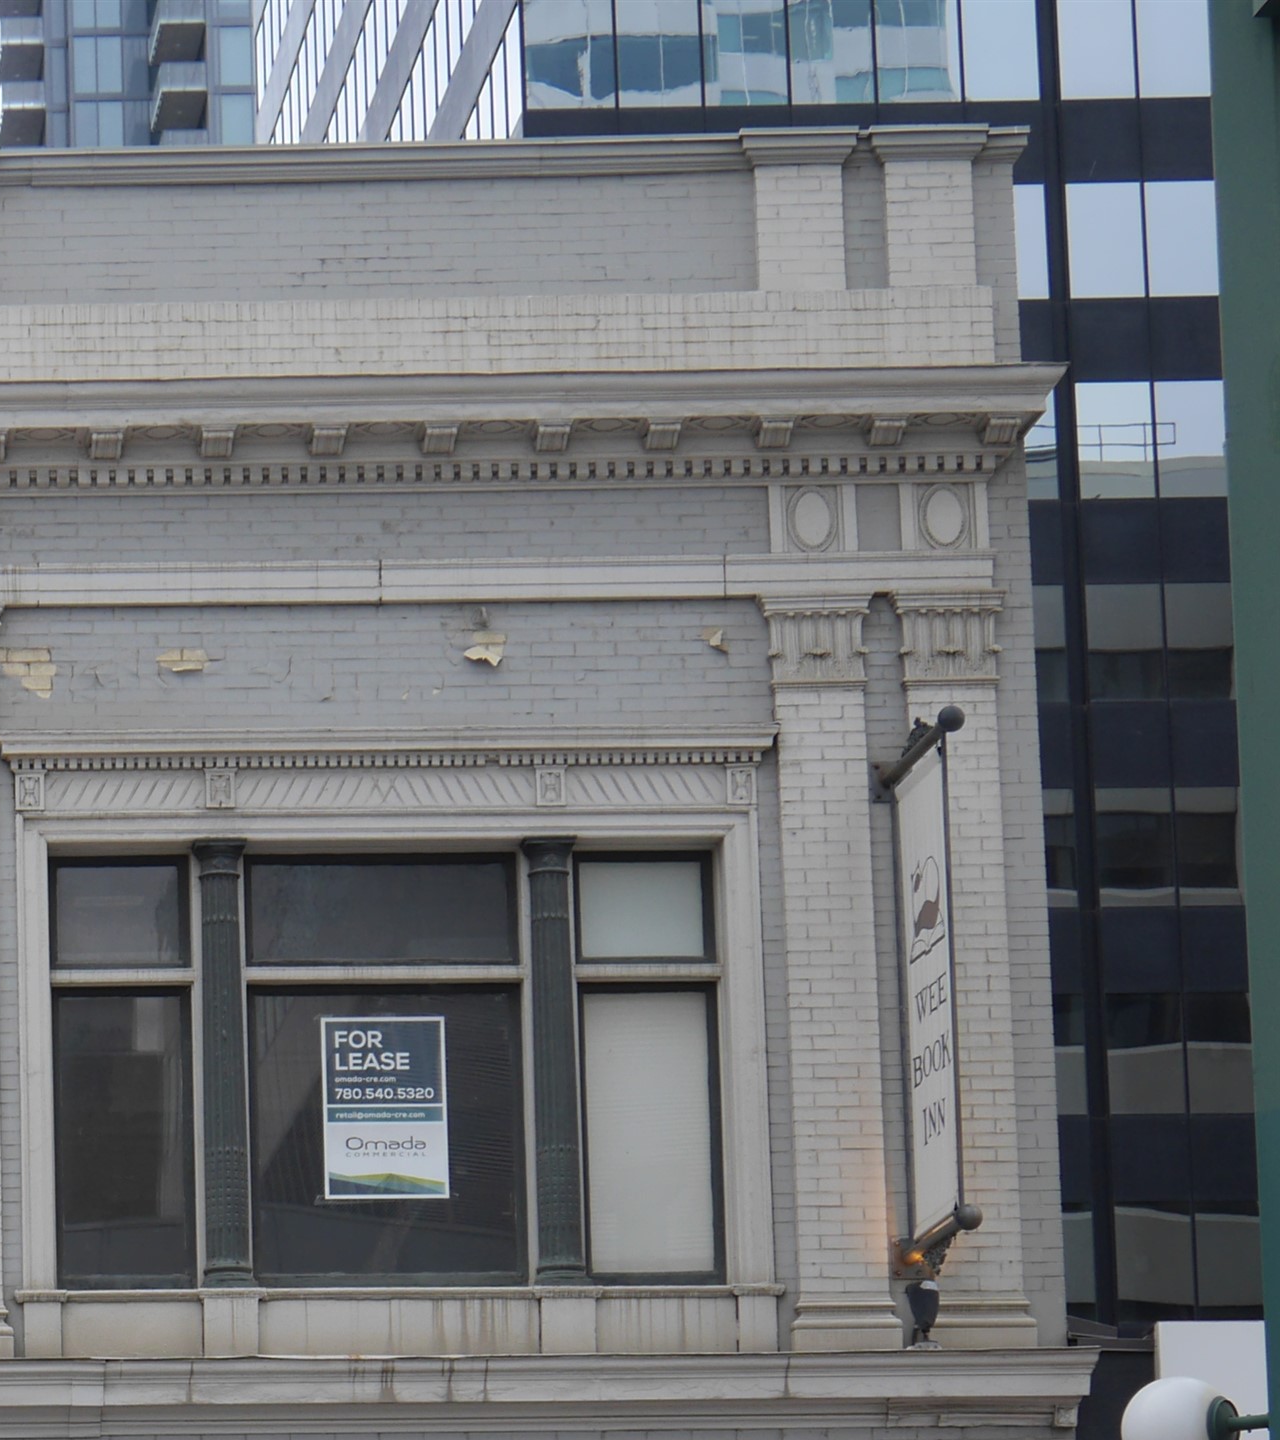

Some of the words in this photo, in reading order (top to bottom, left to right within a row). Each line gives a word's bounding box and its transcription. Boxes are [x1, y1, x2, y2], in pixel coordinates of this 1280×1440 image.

[914, 971, 949, 1023] WEE
[334, 1030, 383, 1049] FOR
[334, 1052, 410, 1071] LEASE
[912, 1033, 953, 1090] BOOK
[335, 1087, 435, 1100] 780.540.5320
[921, 1097, 948, 1147] INN
[345, 1135, 427, 1151] Omada
